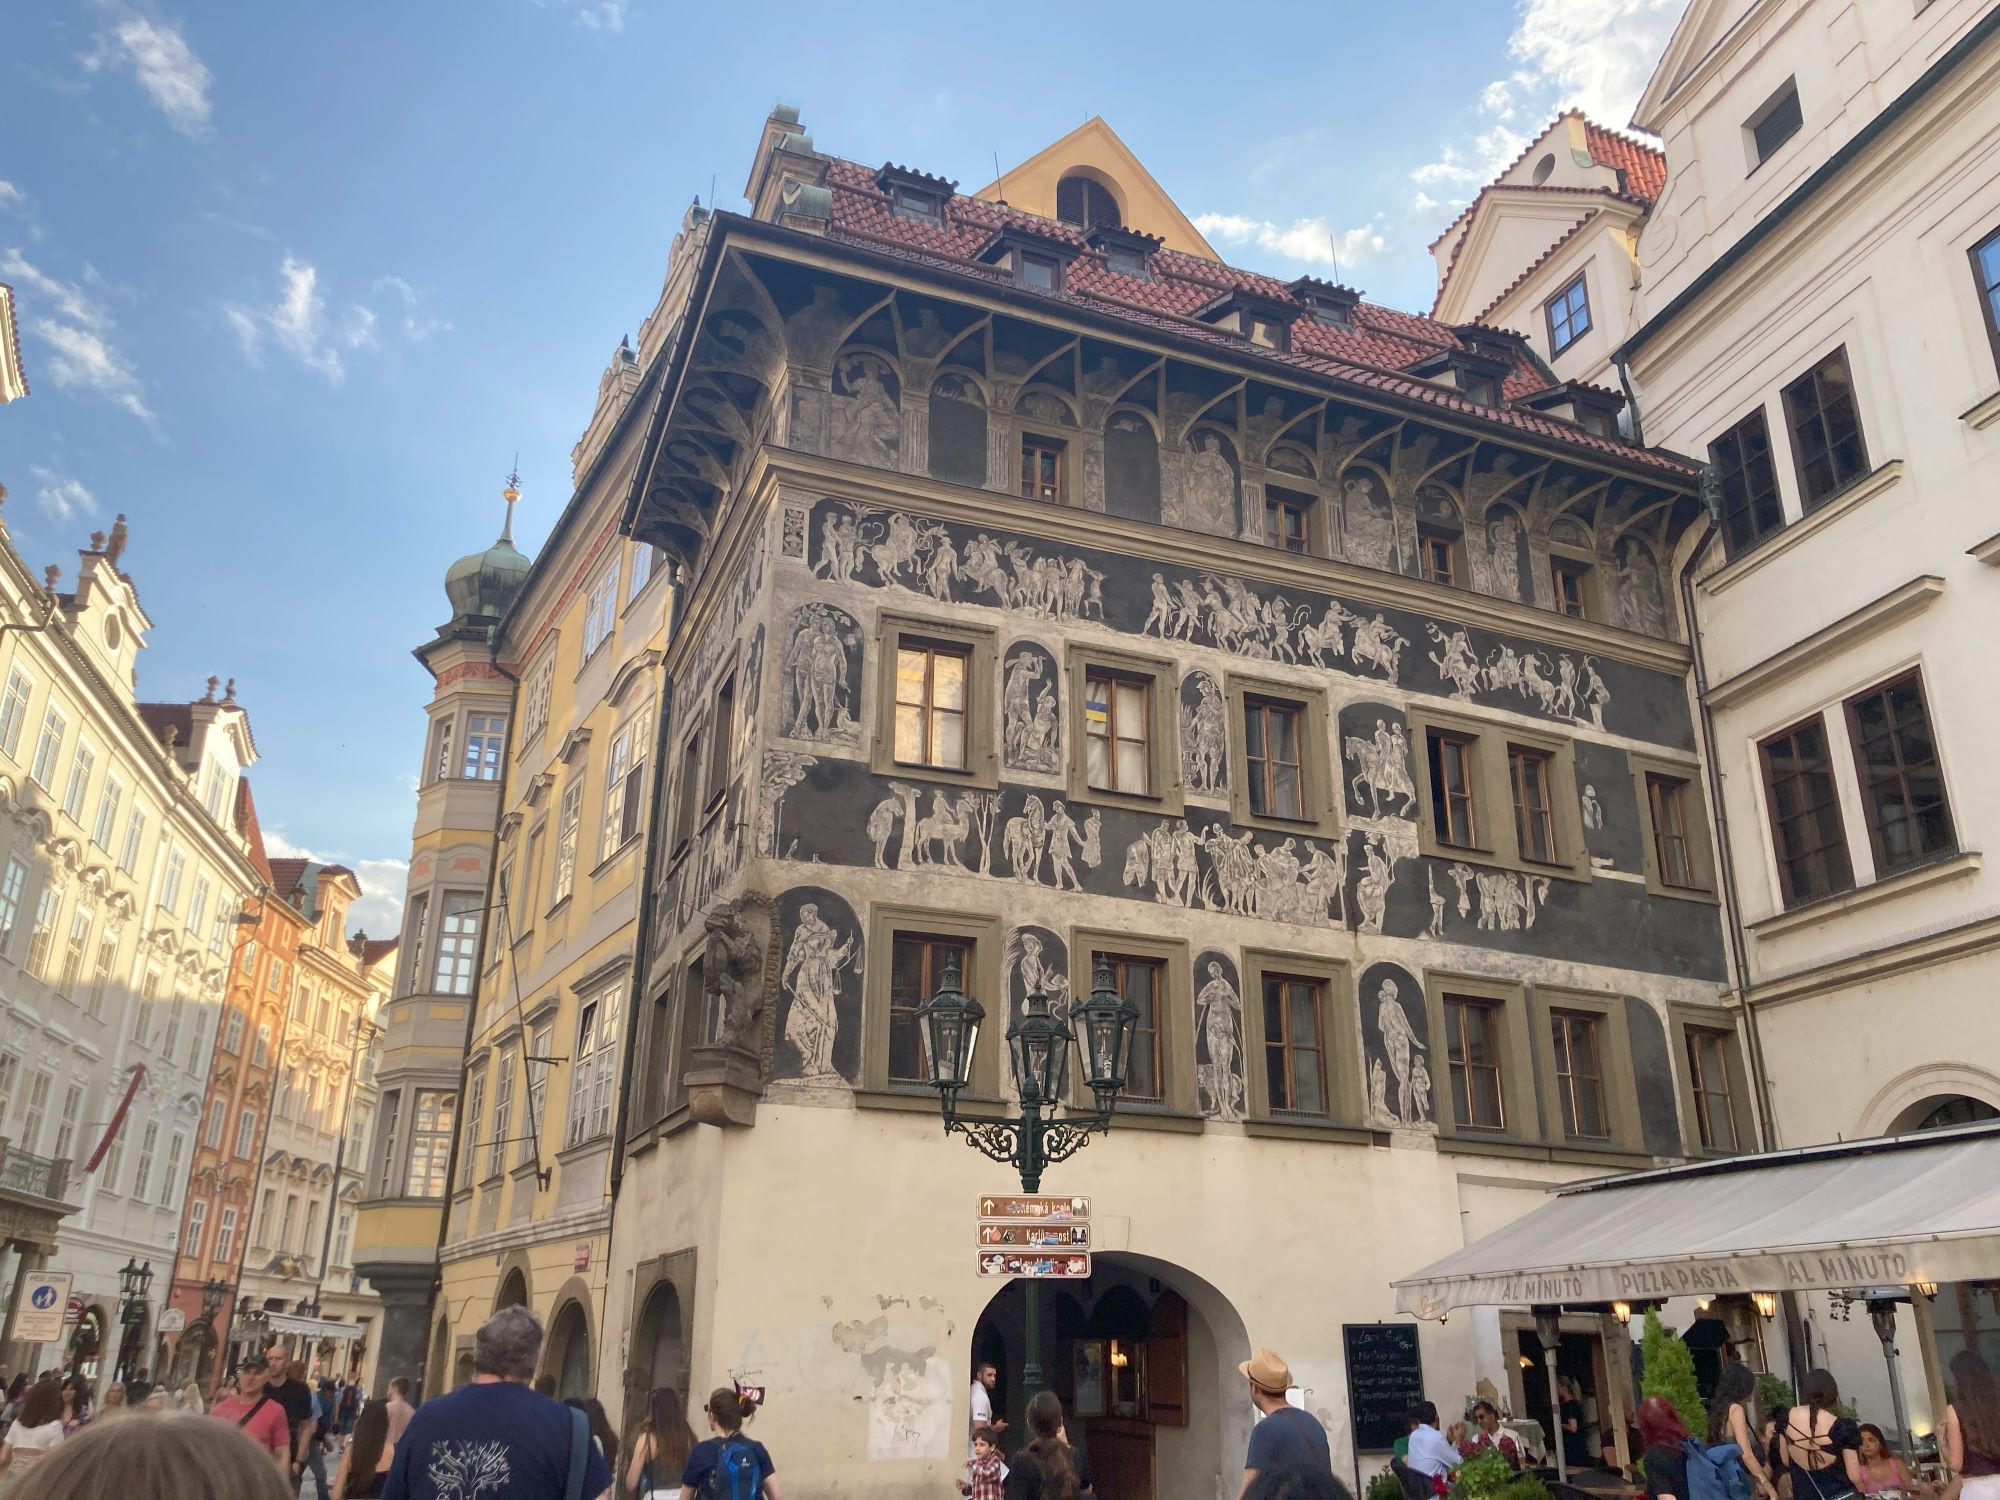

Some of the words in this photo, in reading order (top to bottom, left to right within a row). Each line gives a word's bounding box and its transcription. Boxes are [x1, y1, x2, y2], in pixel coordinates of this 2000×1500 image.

[1620, 1269, 1677, 1295] PIZZA
[1678, 1265, 1740, 1290] PASTA
[1785, 1260, 1816, 1284] AL
[1818, 1253, 1907, 1283] MINUTO
[1501, 1280, 1519, 1301] AL
[1524, 1276, 1584, 1300] MINUTO
